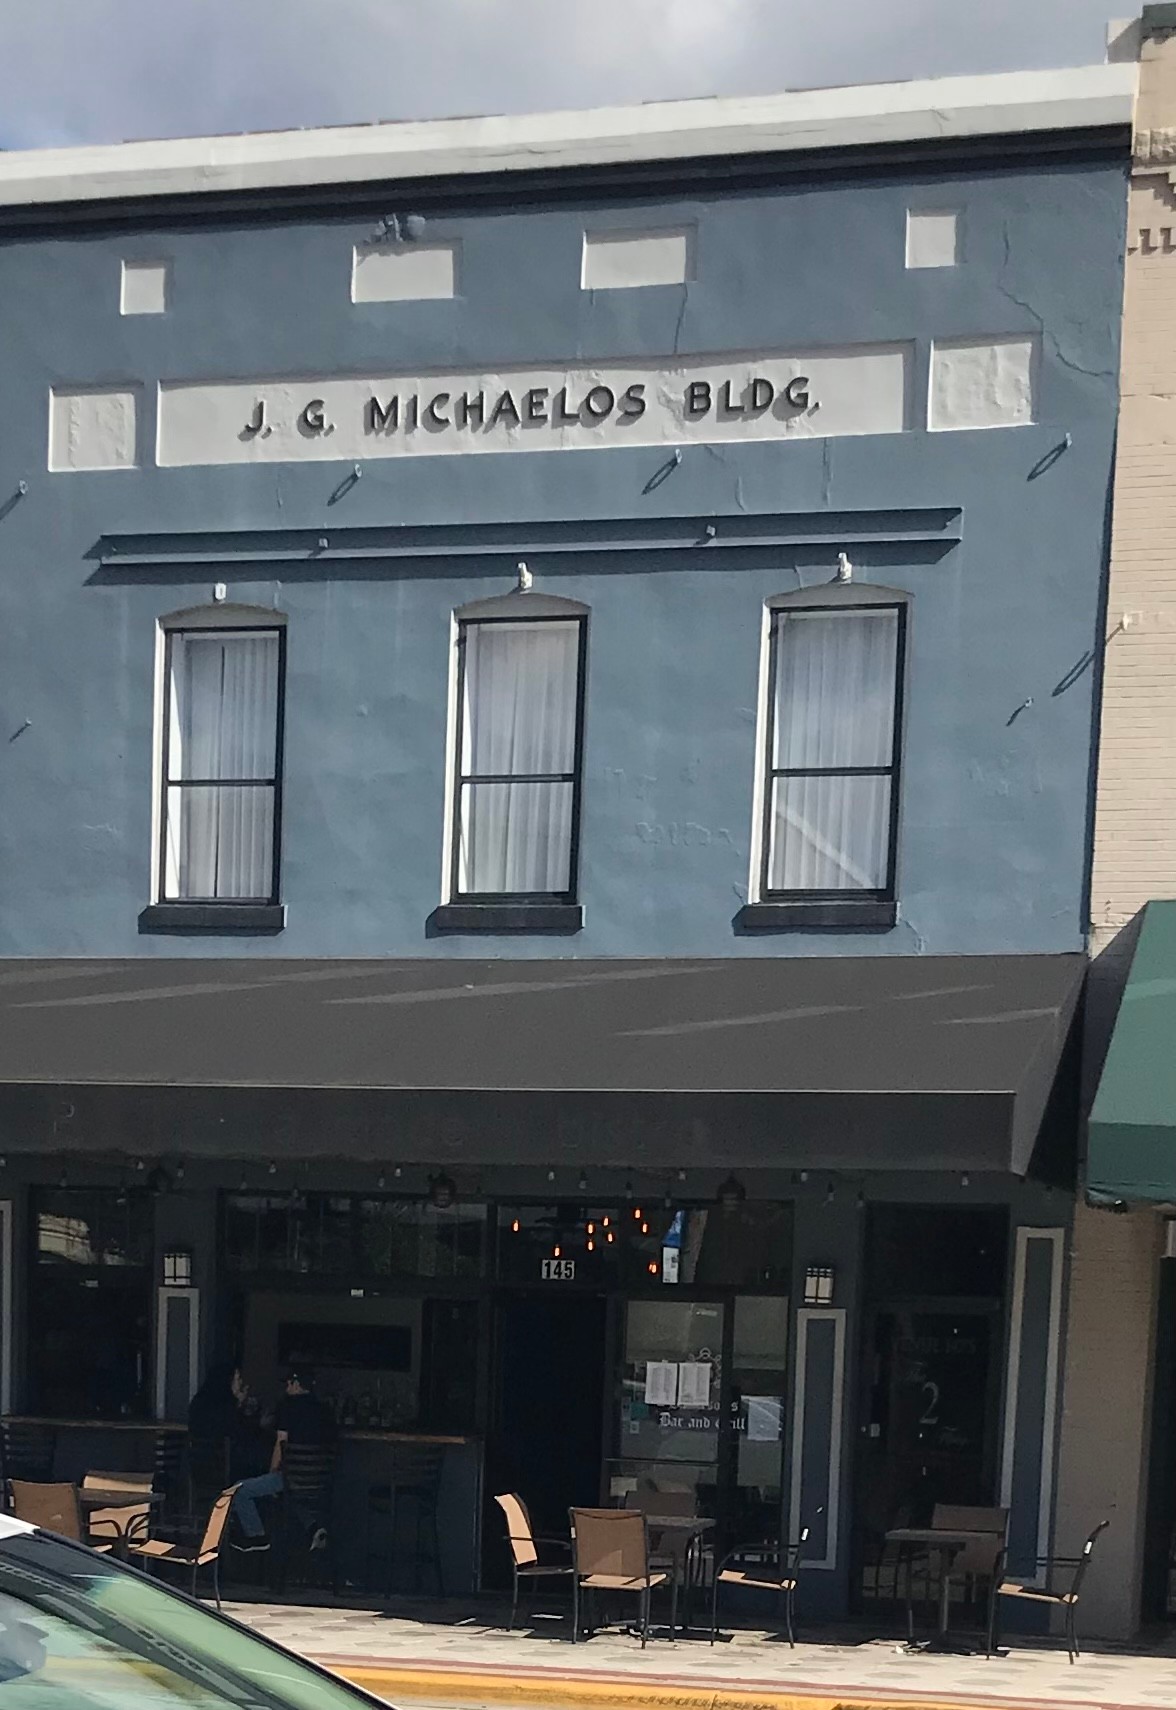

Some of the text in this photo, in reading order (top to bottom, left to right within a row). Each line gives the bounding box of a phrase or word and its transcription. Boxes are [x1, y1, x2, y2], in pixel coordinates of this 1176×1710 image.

[242, 377, 822, 436] J. G. MICHAELOS BLDG.
[543, 1260, 574, 1279] 145
[919, 1381, 940, 1425] 2
[659, 1412, 684, 1428] Bar
[688, 1416, 711, 1429] and
